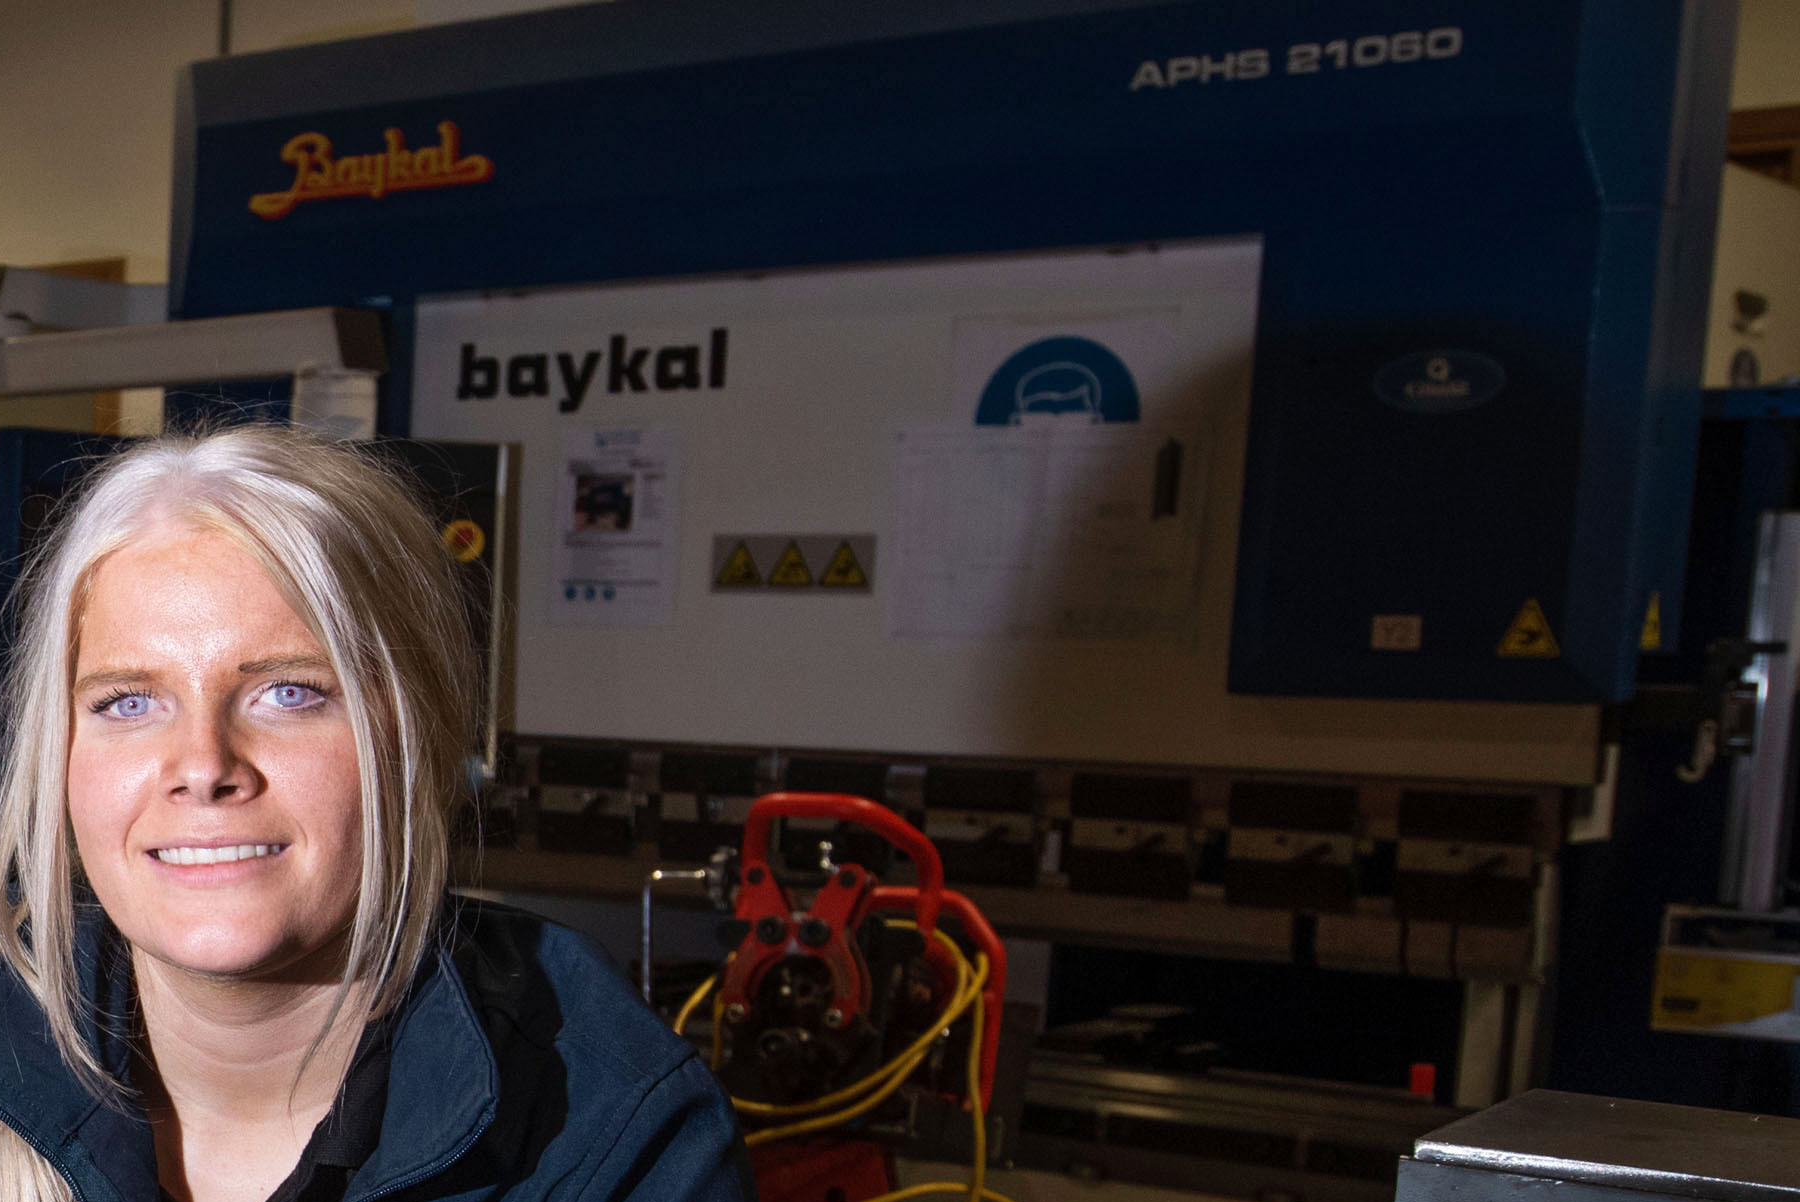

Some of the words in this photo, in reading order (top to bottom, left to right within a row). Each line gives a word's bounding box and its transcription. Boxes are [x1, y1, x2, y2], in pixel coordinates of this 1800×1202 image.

[1128, 47, 1272, 92] APHS
[1286, 26, 1464, 76] 21060
[248, 119, 496, 220] Baykal
[456, 327, 728, 413] baykal
